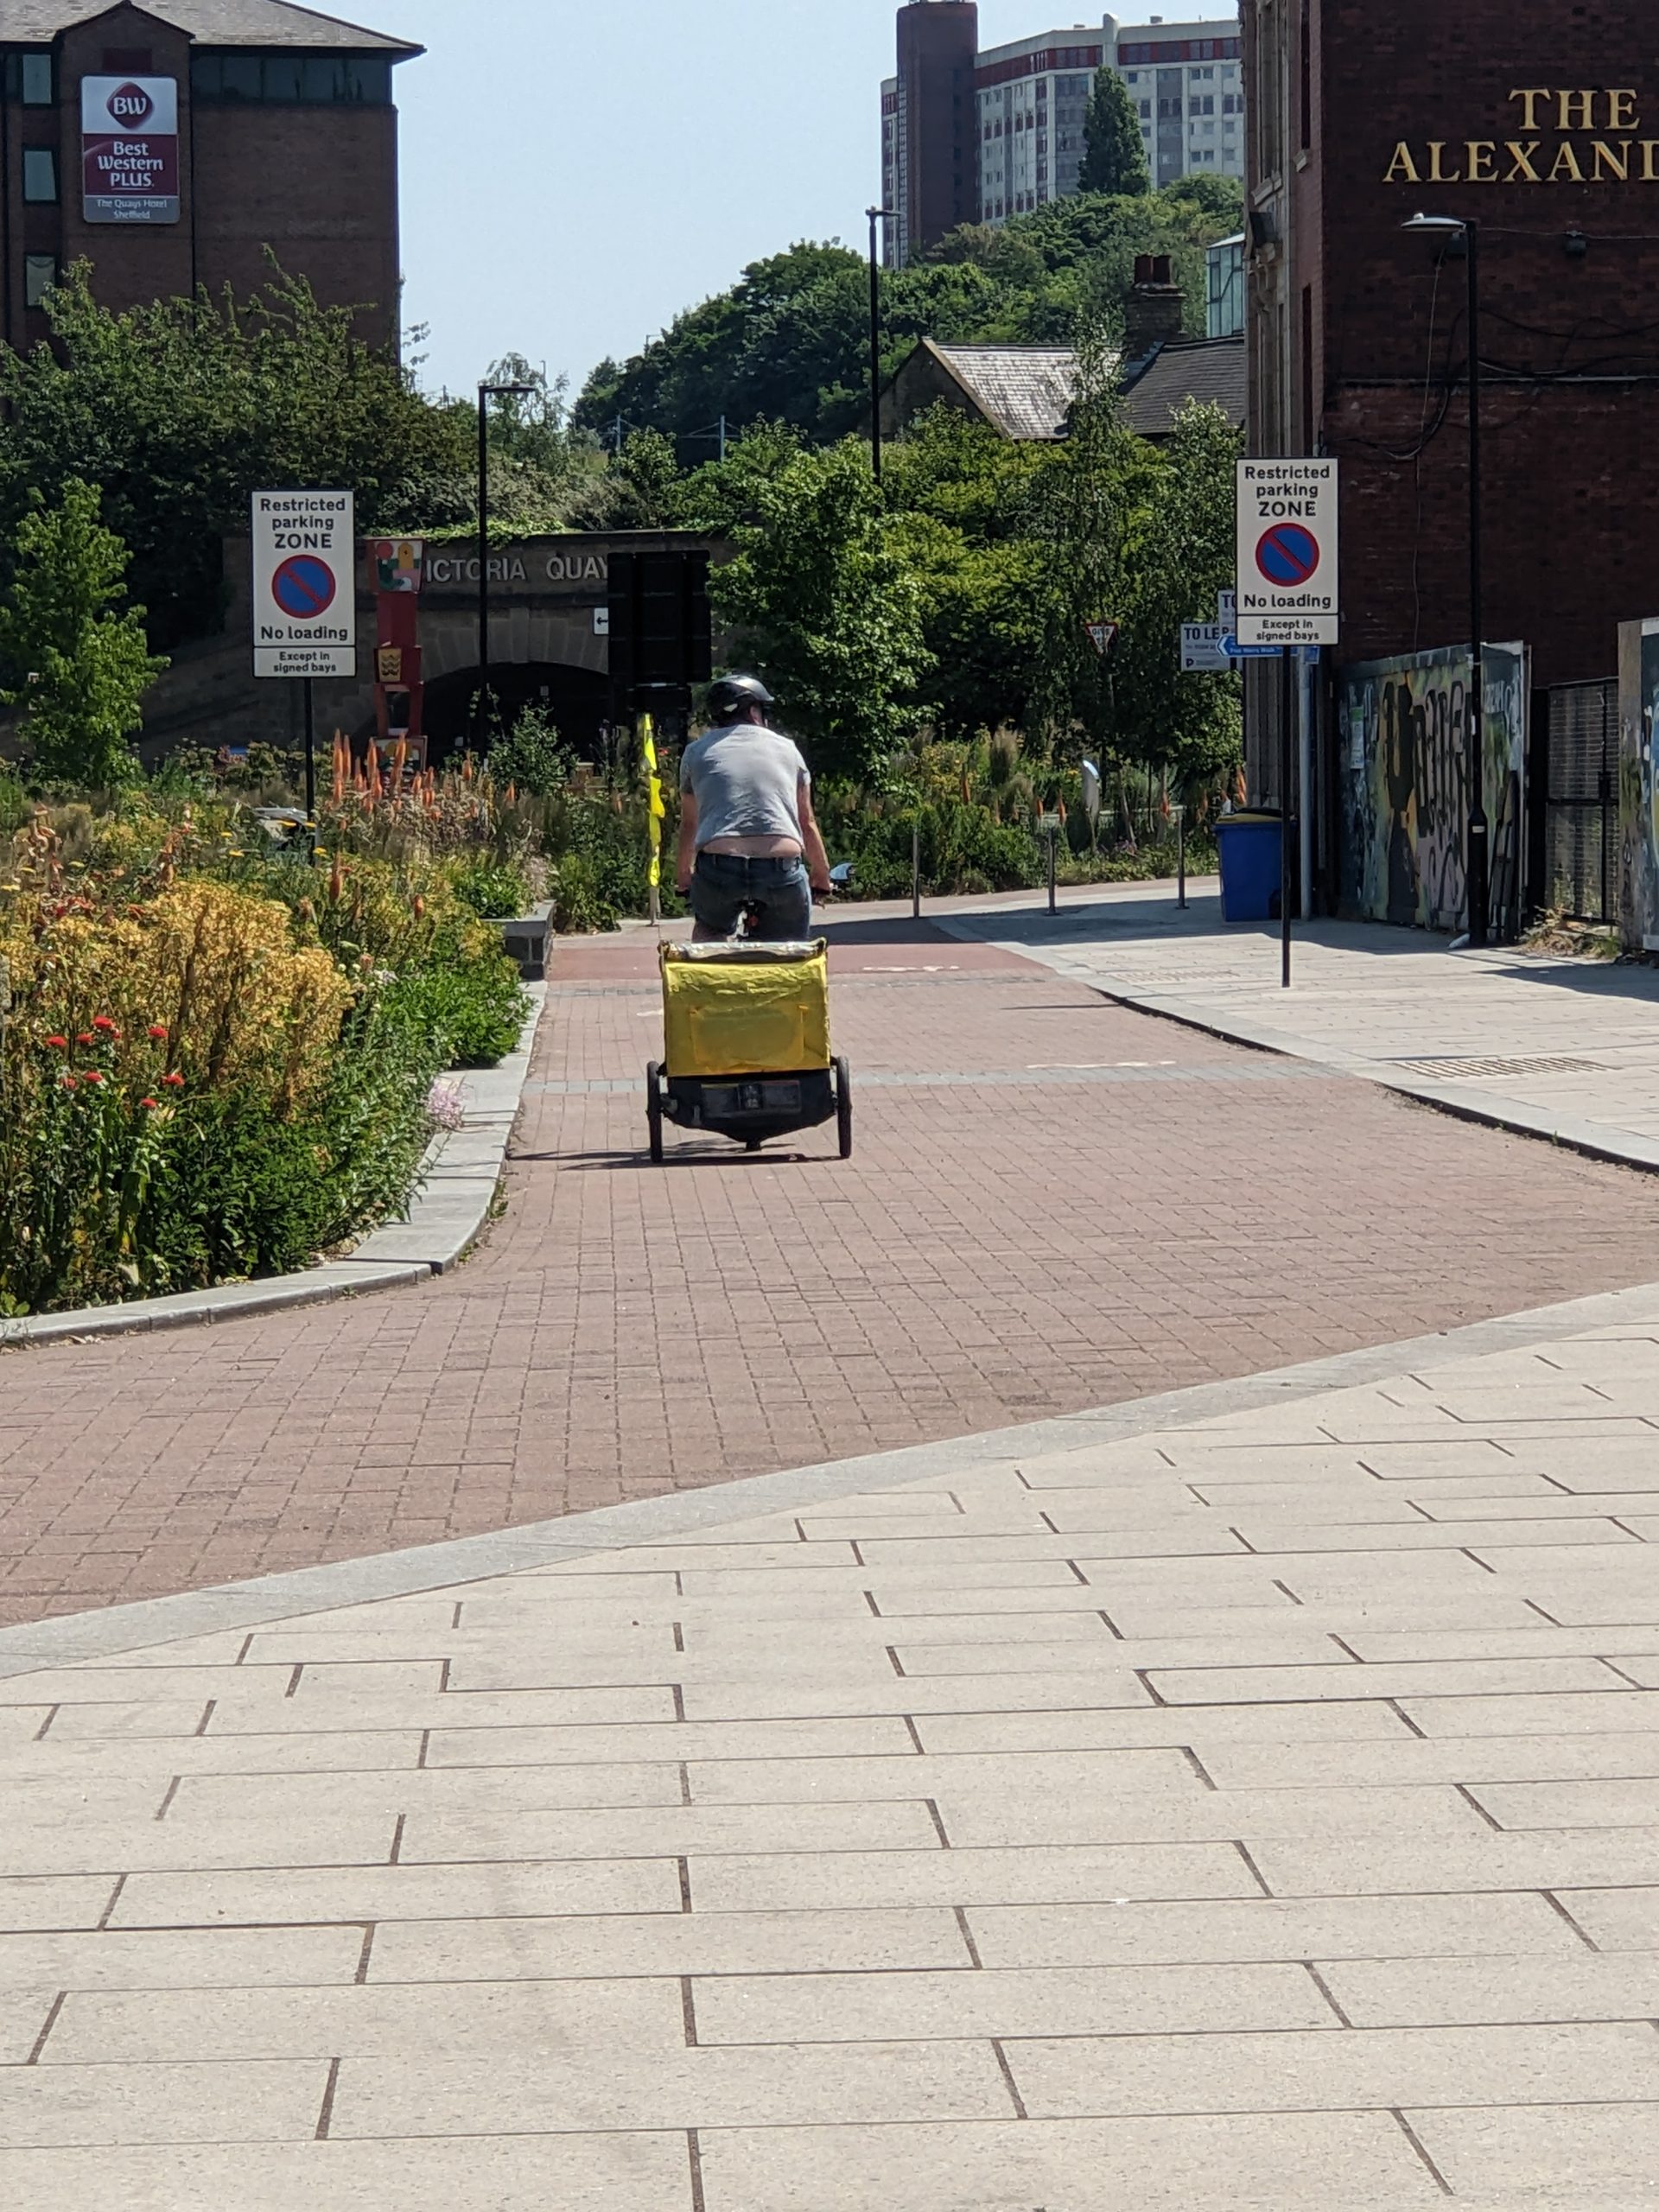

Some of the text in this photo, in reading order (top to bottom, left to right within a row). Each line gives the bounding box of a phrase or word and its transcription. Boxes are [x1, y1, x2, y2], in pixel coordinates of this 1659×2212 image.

[113, 97, 147, 115] BW
[1508, 88, 1640, 130] THE
[113, 142, 149, 156] Best
[98, 156, 163, 171] Western
[1244, 466, 1330, 480] Restricted
[1256, 484, 1319, 499] parking
[260, 498, 346, 512] Restricted
[1258, 501, 1316, 517] ZONE
[272, 515, 334, 531] parking
[274, 533, 332, 549] ZONE
[426, 557, 526, 582] ICTORIA
[1244, 594, 1332, 609] No loading
[1262, 619, 1313, 630] Except in
[261, 626, 348, 641] No loading
[1184, 627, 1219, 640] TO LE
[1256, 631, 1319, 642] signed bays
[279, 652, 330, 662] Except in
[273, 663, 336, 675] signed bays
